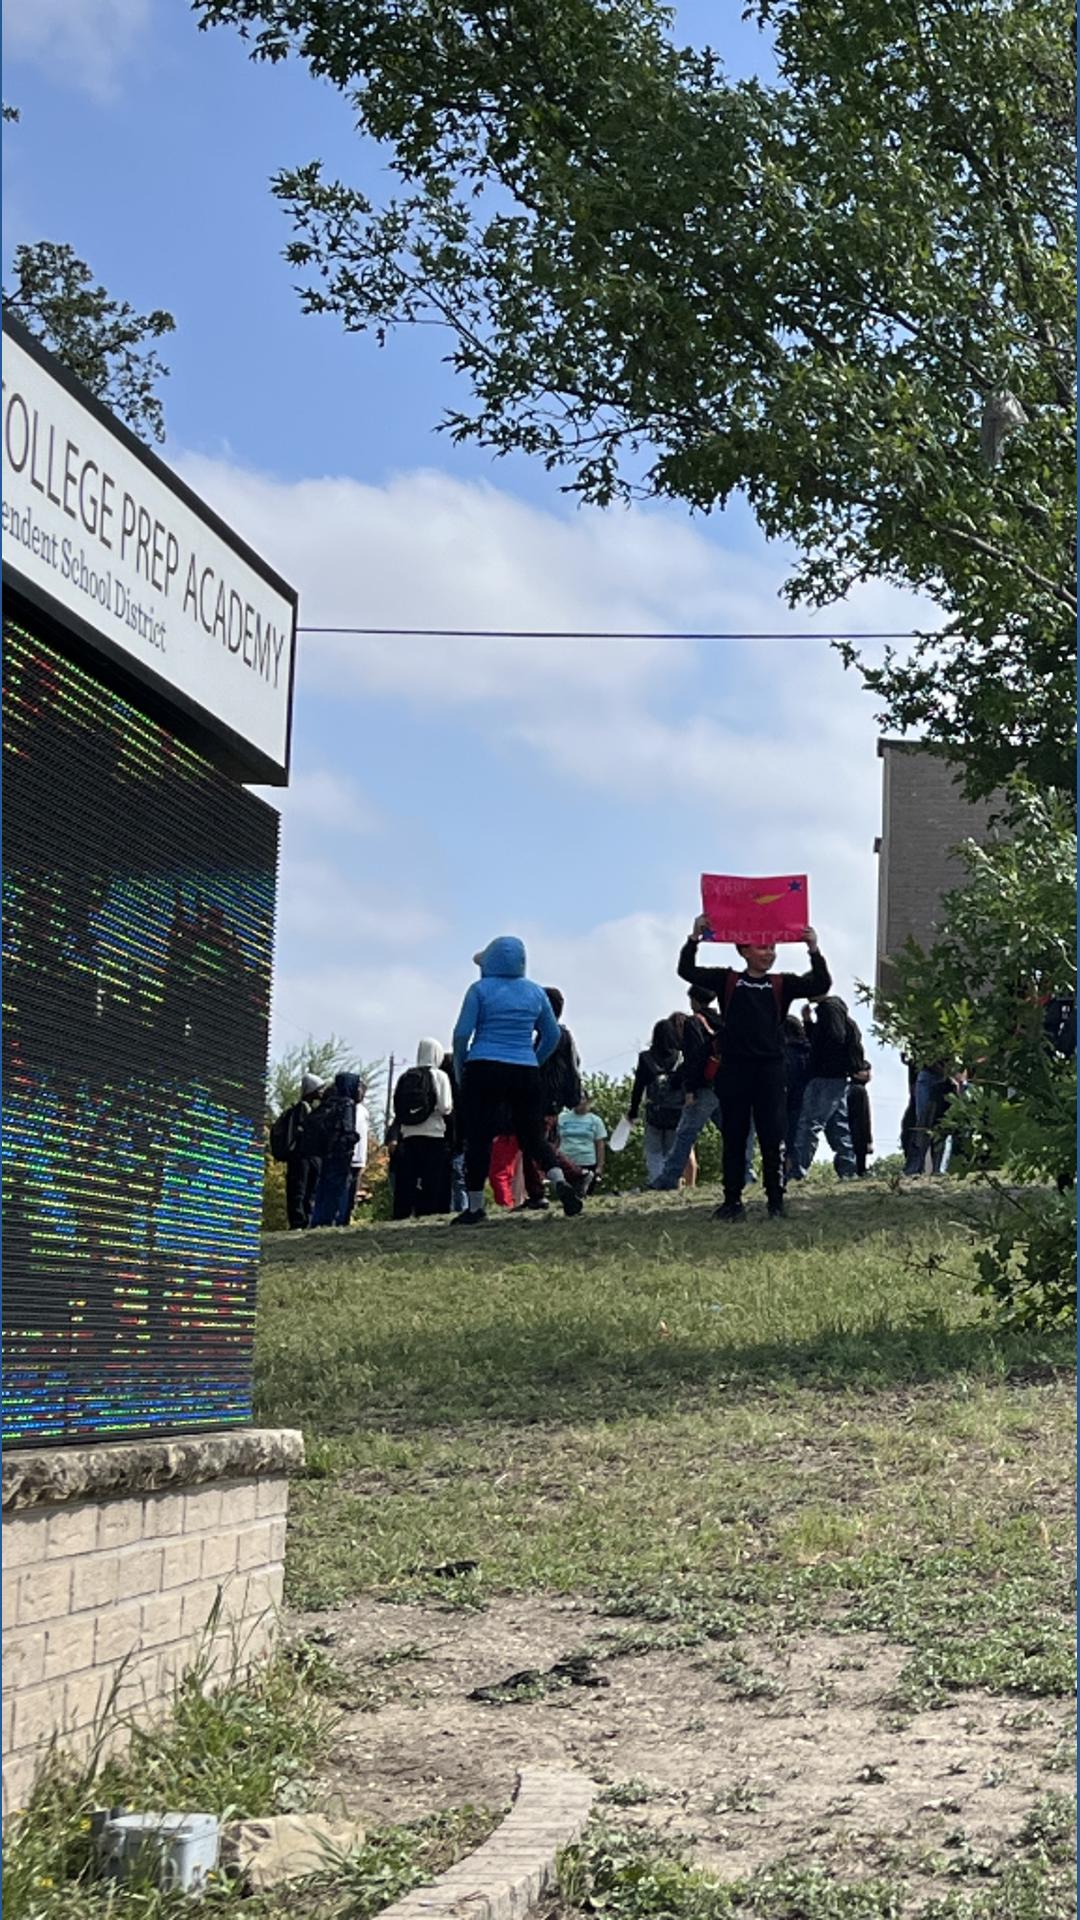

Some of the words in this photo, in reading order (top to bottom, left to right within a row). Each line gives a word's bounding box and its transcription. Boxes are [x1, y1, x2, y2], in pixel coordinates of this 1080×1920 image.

[2, 380, 115, 550] OLLEGE
[121, 492, 179, 597] PREP
[183, 552, 285, 689] ACADEMY
[60, 537, 111, 607] School
[114, 579, 167, 653] District
